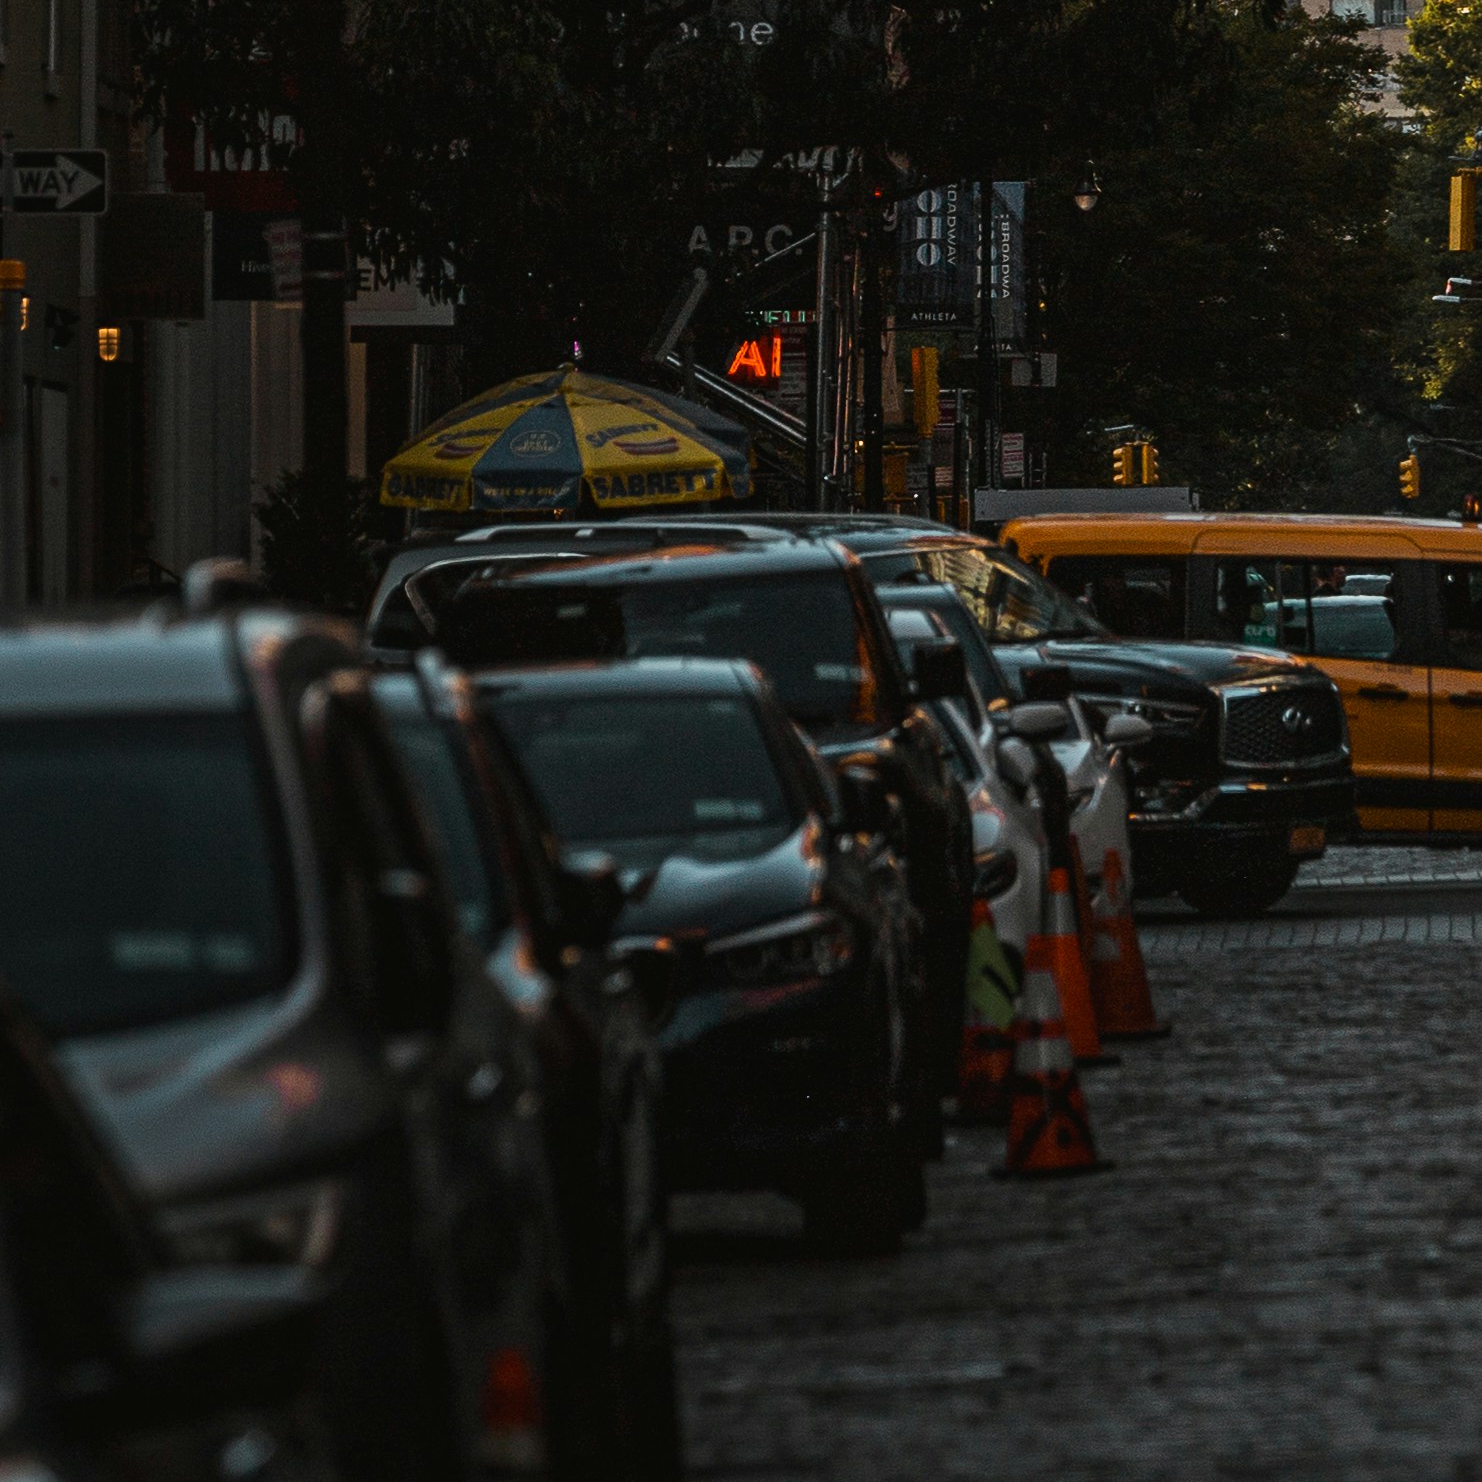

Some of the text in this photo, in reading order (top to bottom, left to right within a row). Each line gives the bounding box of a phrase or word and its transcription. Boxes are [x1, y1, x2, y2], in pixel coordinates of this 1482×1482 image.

[19, 169, 80, 194] WAY
[1001, 221, 1011, 299] BROADWA
[911, 312, 957, 321] ATHLETA
[593, 467, 717, 500] SABRETT
